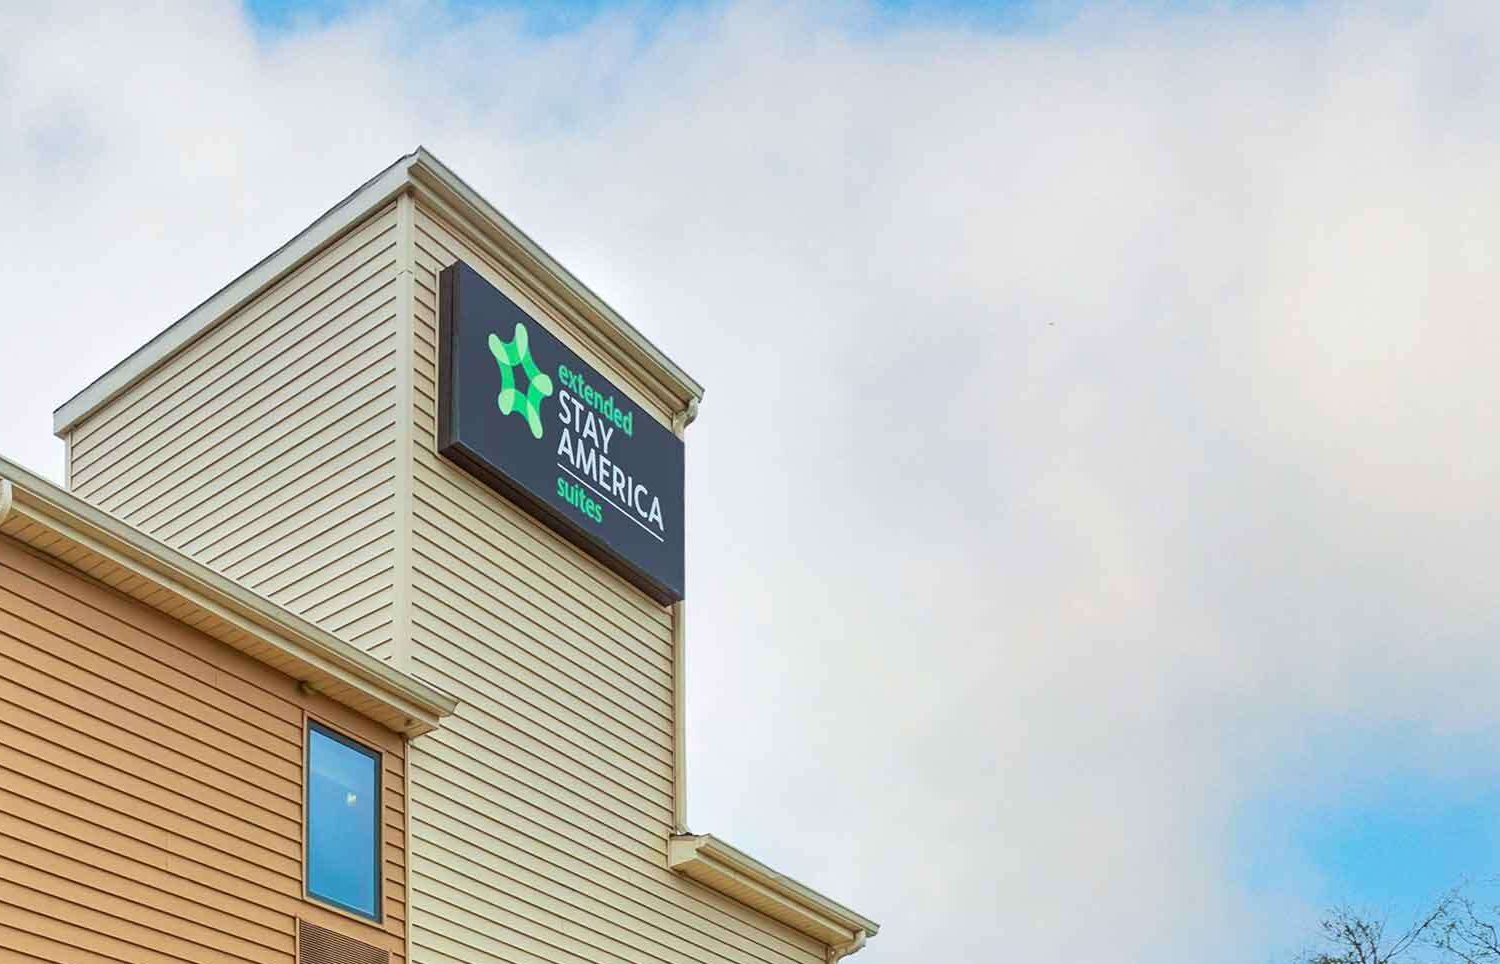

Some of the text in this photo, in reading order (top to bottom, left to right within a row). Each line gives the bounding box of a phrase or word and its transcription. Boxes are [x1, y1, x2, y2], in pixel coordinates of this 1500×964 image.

[558, 365, 633, 436] extended
[558, 390, 614, 454] STAY
[557, 428, 664, 531] AMERICA
[557, 477, 602, 523] suites
